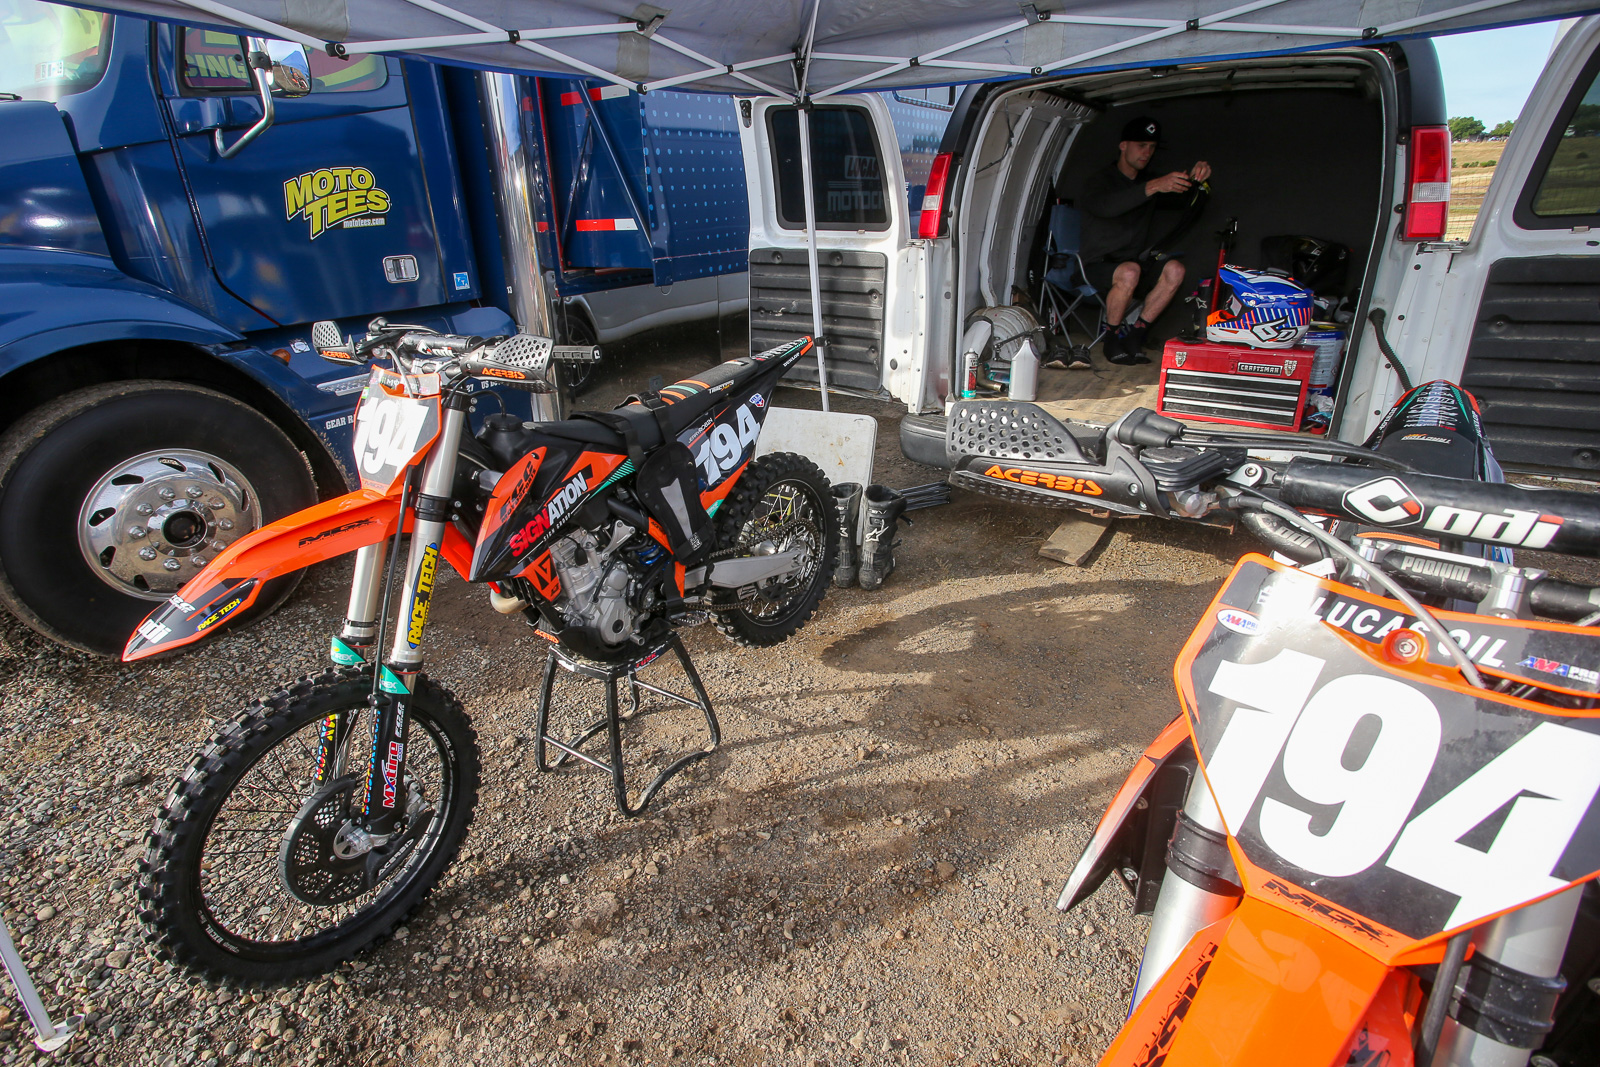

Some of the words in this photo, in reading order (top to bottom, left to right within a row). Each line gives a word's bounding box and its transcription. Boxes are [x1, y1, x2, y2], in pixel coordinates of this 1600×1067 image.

[285, 169, 373, 215] MOTO
[306, 190, 388, 234] TEES
[343, 218, 385, 228] mototees.com
[482, 367, 526, 380] ACERBIS
[1240, 363, 1281, 374] CRAFTSMAN
[325, 415, 347, 430] GEAR
[353, 396, 430, 478] 194
[695, 403, 761, 486] 194
[984, 464, 1103, 496] ACERBIS
[509, 471, 588, 557] SIGNATION
[416, 545, 438, 593] TECH
[1401, 555, 1471, 582] PODIUM
[197, 613, 220, 632] RACE
[219, 598, 241, 616] TECH
[407, 596, 428, 645] RACE
[1222, 613, 1246, 628] AMA
[1515, 655, 1570, 677] AMA
[1208, 649, 1600, 932] 194
